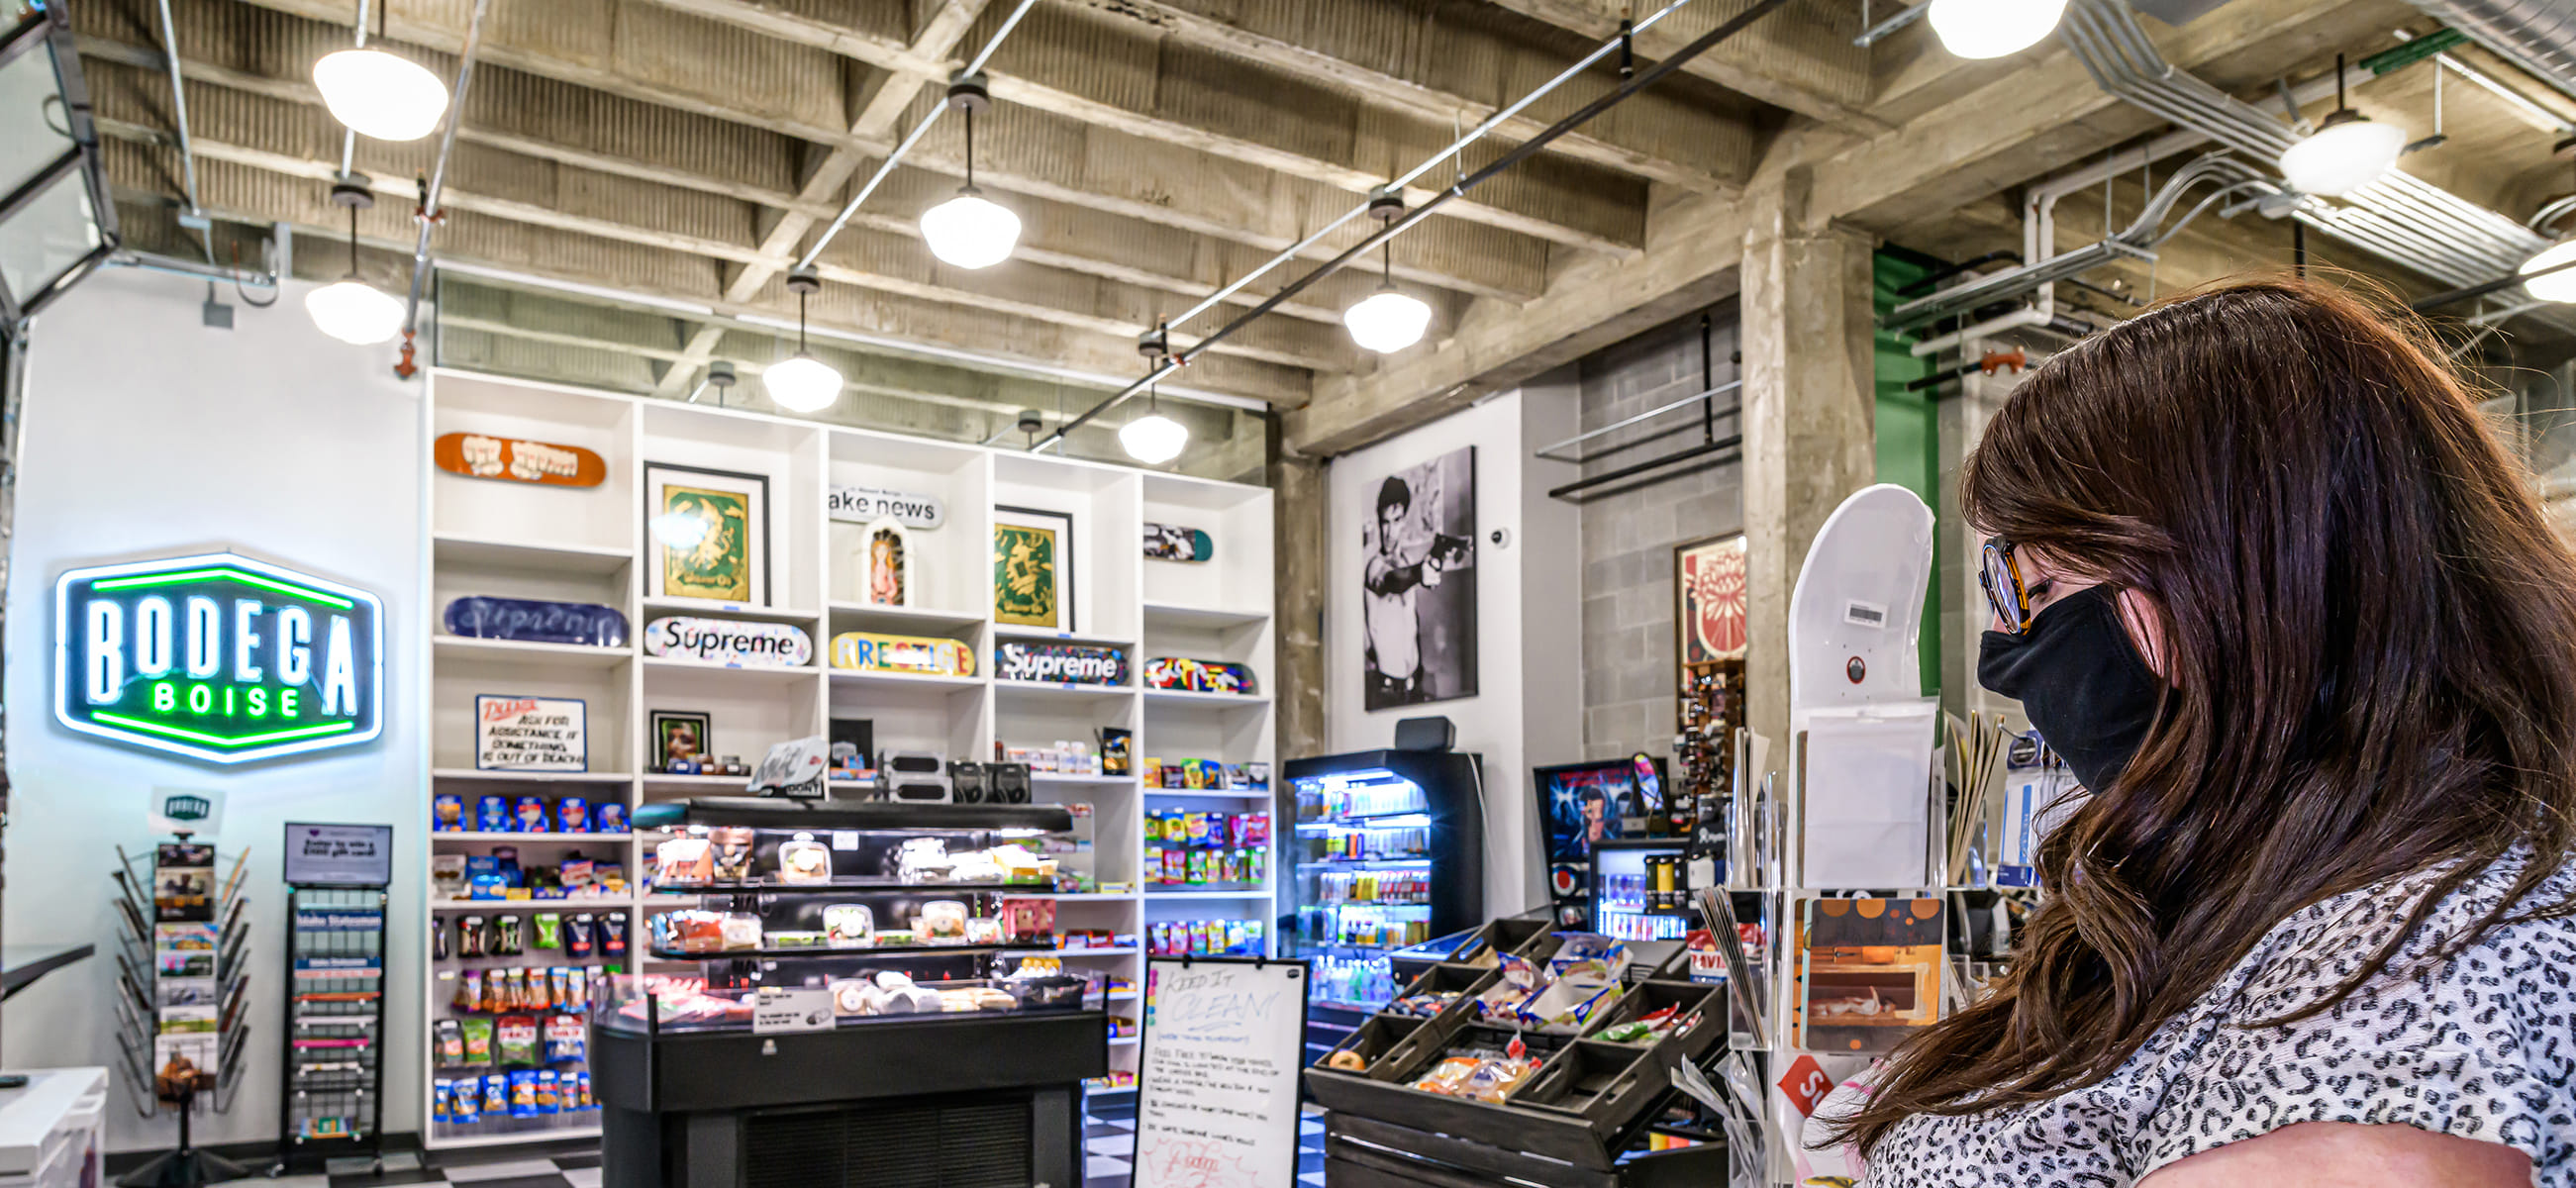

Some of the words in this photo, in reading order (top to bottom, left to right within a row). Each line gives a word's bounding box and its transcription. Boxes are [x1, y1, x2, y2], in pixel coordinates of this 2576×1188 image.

[877, 497, 936, 521] news
[85, 594, 358, 717] BODEGA
[663, 621, 794, 658] Supreme
[1003, 643, 1118, 681] Supreme
[152, 682, 301, 719] BOISE
[497, 752, 521, 762] OUT
[524, 753, 539, 764] OF
[328, 914, 382, 928] Statesman
